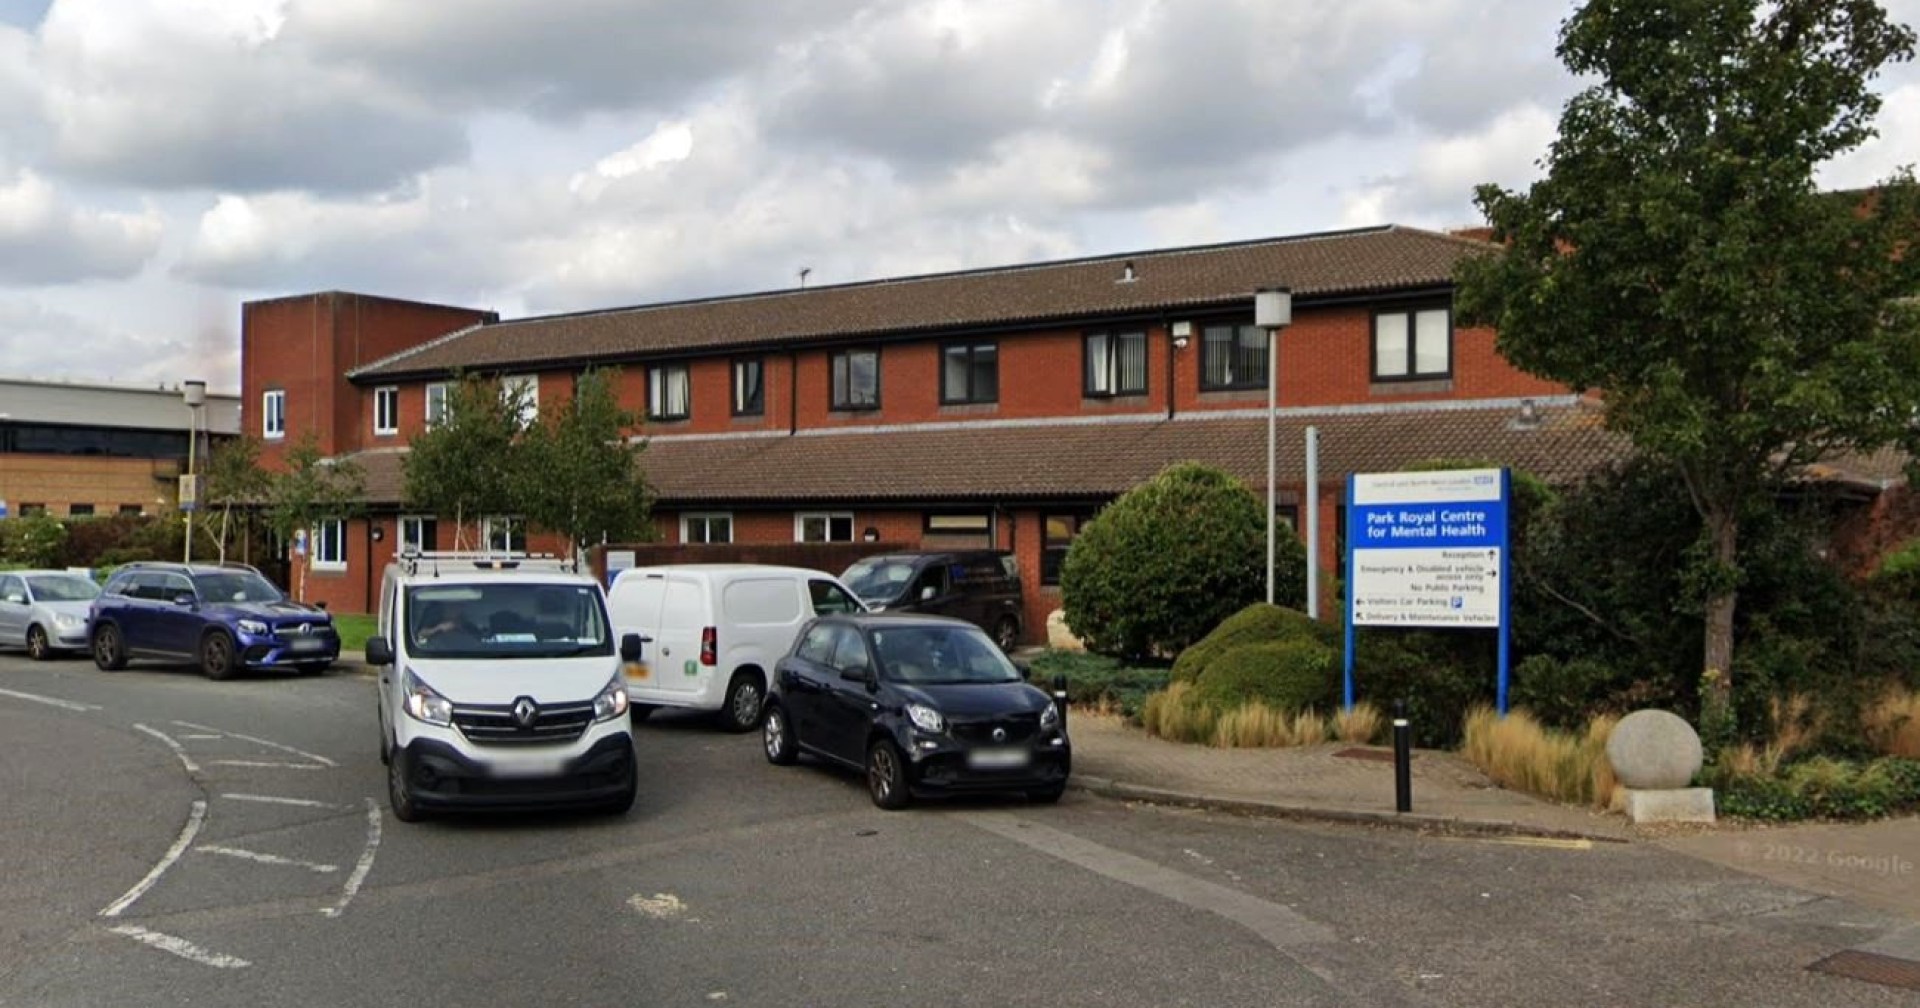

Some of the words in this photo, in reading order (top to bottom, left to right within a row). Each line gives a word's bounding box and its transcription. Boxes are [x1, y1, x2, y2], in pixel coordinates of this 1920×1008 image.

[1367, 511, 1394, 524] Park
[1400, 510, 1436, 526] Royal
[1440, 510, 1486, 523] Centre
[1367, 526, 1386, 538] for
[1391, 525, 1437, 538] Mental
[1441, 523, 1486, 537] Health
[1442, 551, 1484, 559] Reception
[1361, 565, 1404, 574] Emergency
[1408, 565, 1413, 573] &
[1416, 565, 1452, 573] Disabled
[1465, 573, 1484, 582] only
[1410, 583, 1422, 592] No
[1425, 584, 1449, 592] Public
[1452, 584, 1484, 594] Parking
[1368, 598, 1397, 606] Visitors
[1417, 598, 1448, 608] Parking
[1366, 613, 1397, 622] Delivery
[1401, 613, 1406, 621] &
[1408, 613, 1459, 621] Maintenance
